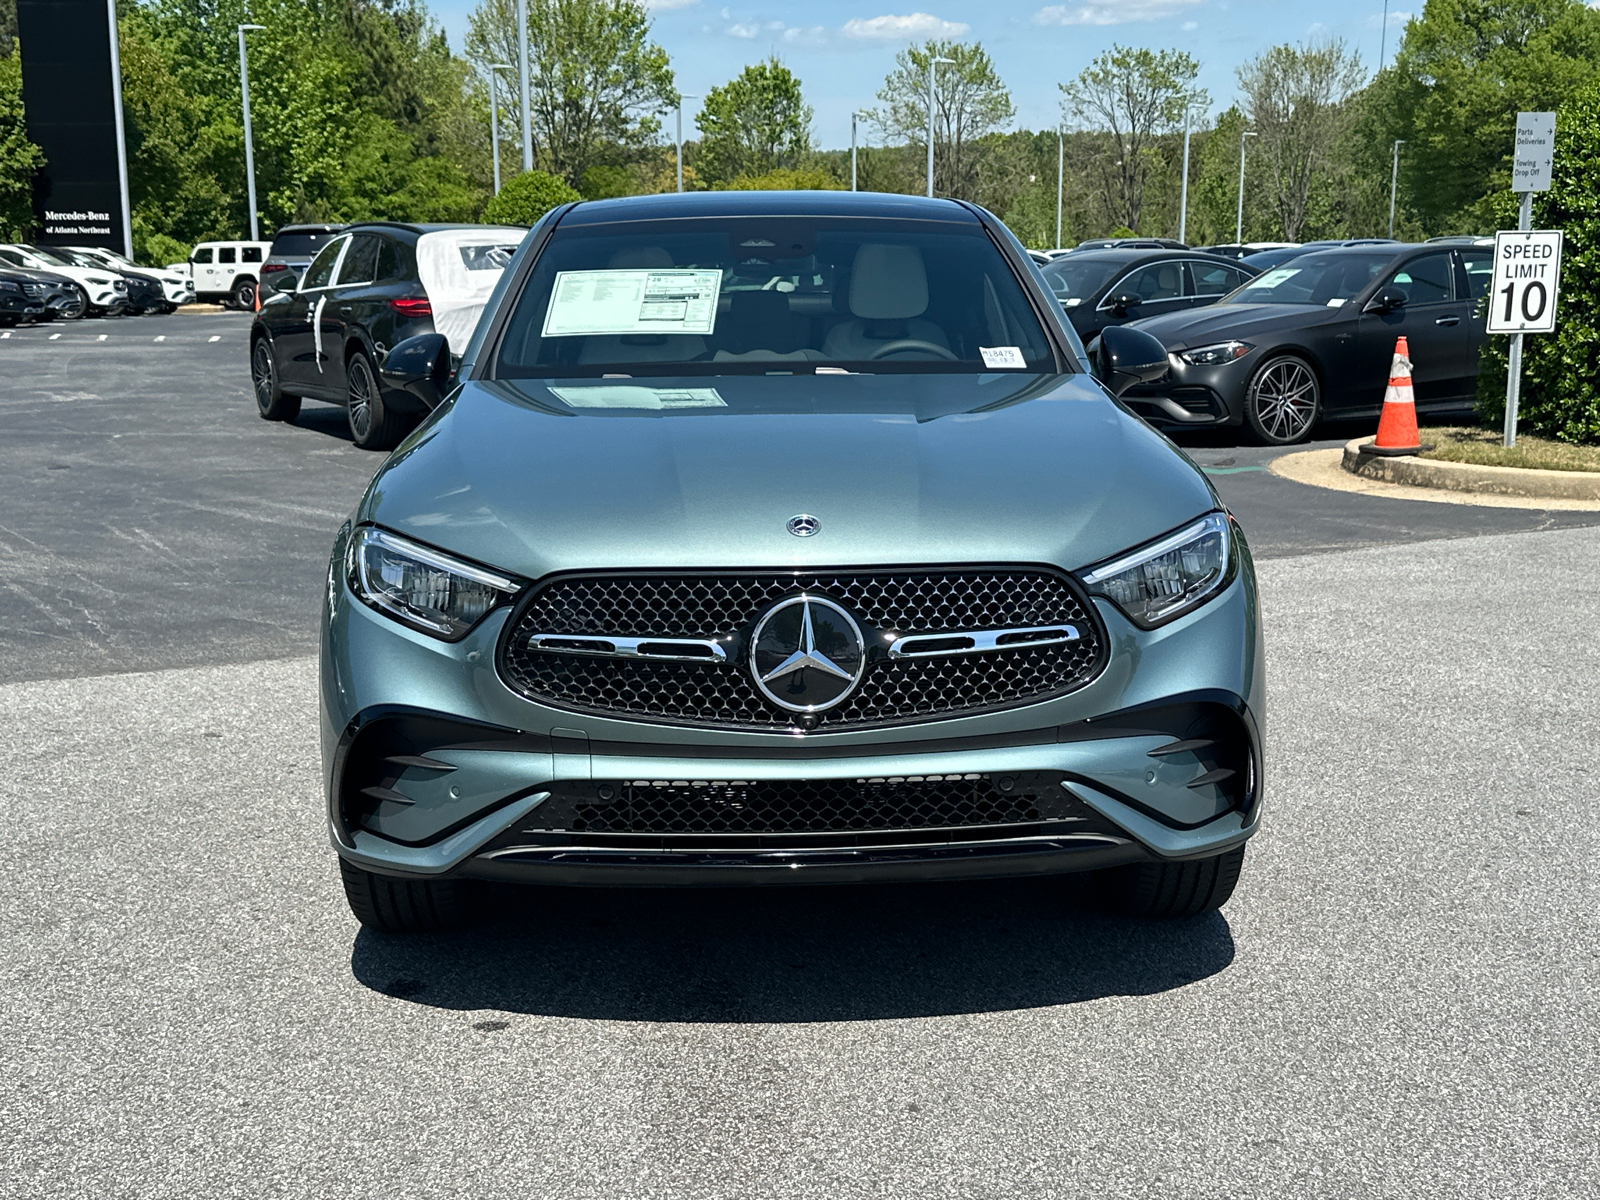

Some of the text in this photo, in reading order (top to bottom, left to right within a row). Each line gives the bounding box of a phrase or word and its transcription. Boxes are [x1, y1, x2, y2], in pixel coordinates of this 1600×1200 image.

[1517, 128, 1533, 136] Parts
[1516, 159, 1537, 168] Towing
[1514, 168, 1540, 178] Drop Off
[45, 211, 110, 220] Mercedes-Benz
[46, 226, 110, 234] of Atlanta Northeast
[1502, 244, 1553, 259] SPEED
[1505, 263, 1548, 279] LIMIT
[1500, 280, 1547, 322] 10
